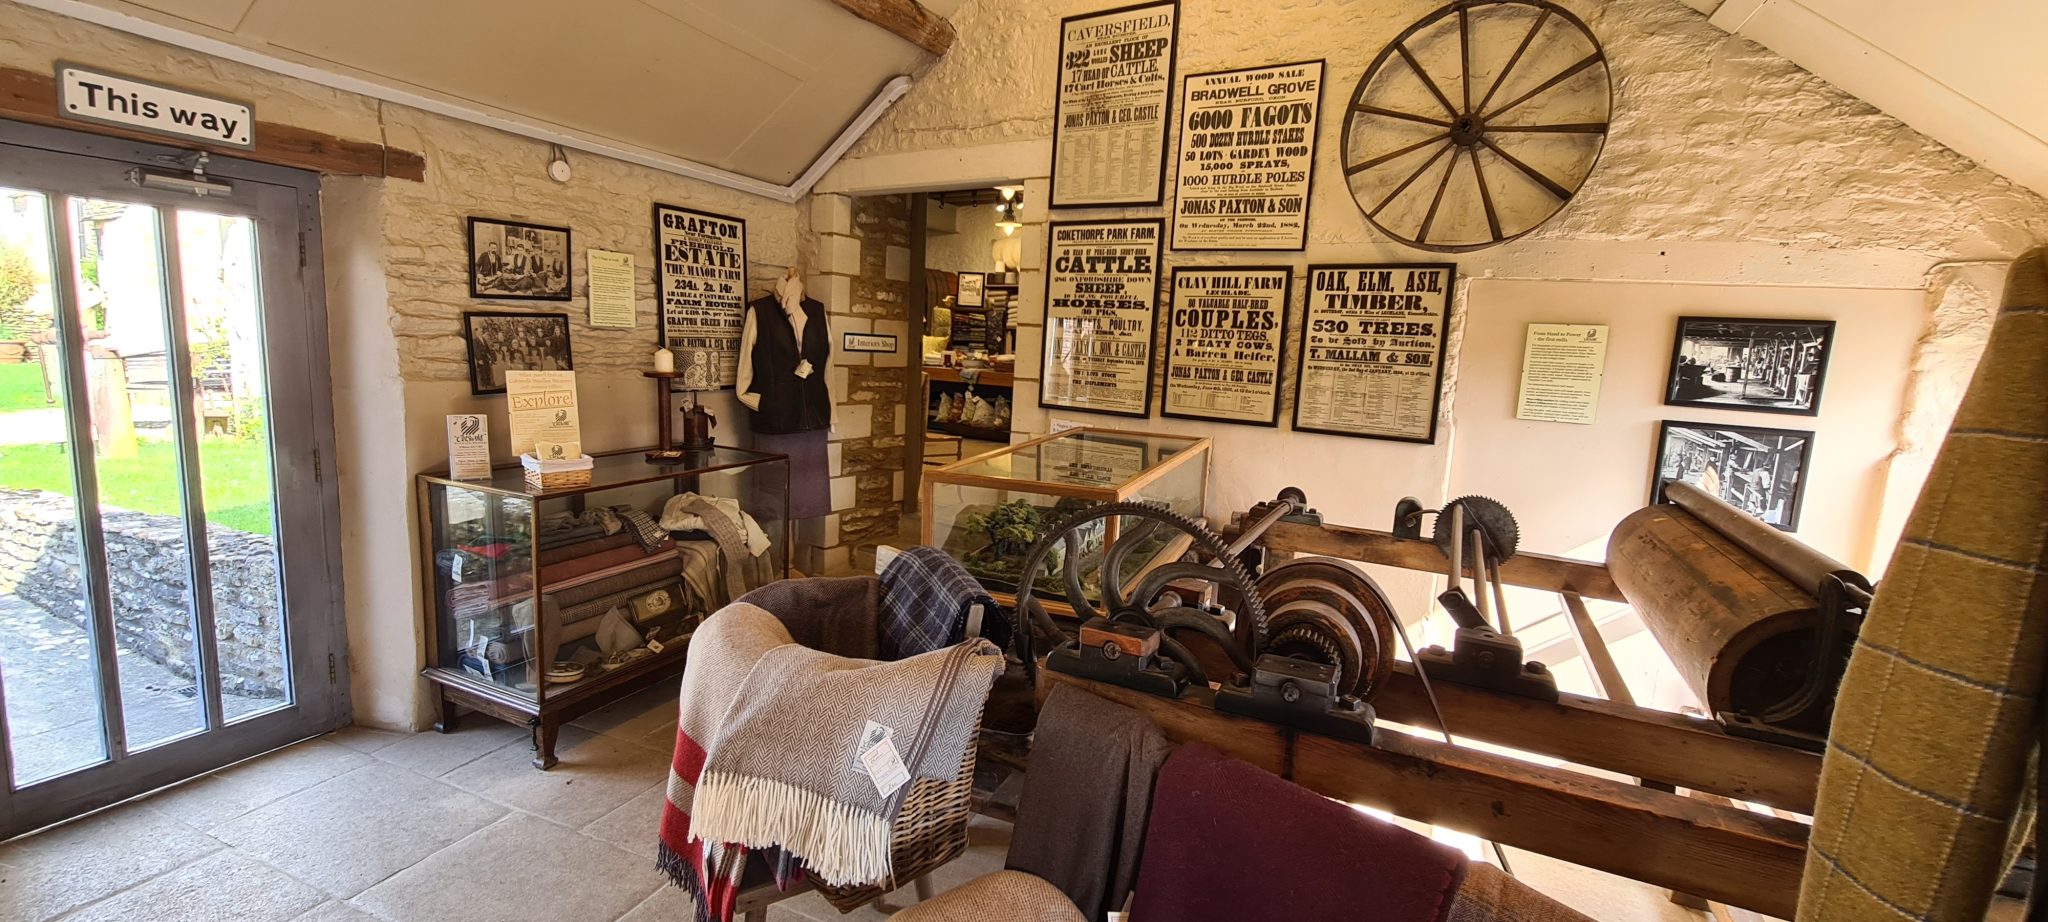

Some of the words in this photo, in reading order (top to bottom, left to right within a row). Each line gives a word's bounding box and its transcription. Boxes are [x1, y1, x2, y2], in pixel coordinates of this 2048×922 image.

[1067, 14, 1171, 42] CAVERSFIELD,
[1109, 37, 1169, 64] SHEEP
[1066, 49, 1090, 70] 322
[1071, 69, 1083, 83] 17
[1083, 68, 1100, 82] HEAD
[1102, 67, 1110, 80] OF
[1204, 75, 1241, 86] ANNUAL
[1246, 72, 1274, 82] WOOD
[1278, 69, 1305, 78] SALE
[1064, 84, 1075, 93] 17
[1075, 81, 1094, 92] Cart
[1096, 78, 1129, 89] Horses
[1191, 85, 1264, 101] BRADWELL
[1268, 80, 1316, 95] GROVE
[78, 81, 159, 119] This
[170, 106, 238, 139] way
[1064, 113, 1084, 128] JONAS
[1085, 109, 1110, 126] PAXTON
[1112, 110, 1117, 123] &
[1134, 105, 1159, 121] CASTLE
[1188, 109, 1233, 131] 6000
[1240, 102, 1313, 129] FAGOTS
[1191, 133, 1207, 148] 500
[1209, 131, 1234, 148] DOZEN
[1236, 130, 1271, 146] HURDLE
[1272, 127, 1305, 144] STAKES
[1185, 151, 1196, 161] 50
[1200, 150, 1224, 161] LOTS
[1230, 148, 1270, 159] GARDEN
[1276, 146, 1308, 158] WOOD
[1200, 162, 1233, 172] 15,000
[1240, 159, 1290, 170] SPRAYS,
[1183, 175, 1208, 186] 1000
[1212, 173, 1262, 185] HURDLE
[1266, 171, 1305, 184] POLES
[1181, 200, 1216, 215] JONAS
[1218, 198, 1267, 214] PAXTON
[1268, 198, 1276, 213] &
[1278, 197, 1303, 213] SON
[1057, 228, 1105, 241] COKETHORPE
[1107, 228, 1128, 240] PARK
[671, 239, 734, 252] FREEHOLD
[664, 244, 741, 269] ESTATE
[665, 263, 685, 275] THE
[688, 265, 716, 278] MANOR
[718, 268, 741, 281] FARM
[1055, 256, 1152, 275] CATTLE,
[1075, 283, 1127, 295] SHEEP,
[1178, 277, 1209, 289] CLAY
[1211, 277, 1242, 289] HILL
[1244, 277, 1283, 290] FARM
[1316, 271, 1350, 295] OAK,
[1357, 271, 1395, 293] ELM,
[1404, 271, 1443, 295] ASH,
[666, 298, 702, 307] FARM
[667, 291, 692, 299] ARABLE
[1199, 299, 1230, 309] VALUABLE
[1232, 299, 1269, 310] HALF-BRED
[1324, 294, 1429, 313] TIMBER,
[667, 316, 697, 326] GRAFTON
[701, 318, 720, 327] GREEN
[1109, 319, 1144, 332] POULTRY,
[1175, 309, 1279, 331] COUPLES,
[1312, 320, 1349, 333] 530
[1181, 328, 1198, 338] 112
[1200, 329, 1235, 340] DITTO
[1328, 336, 1338, 344] be
[1343, 336, 1367, 345] Sold
[1373, 337, 1386, 347] by
[687, 339, 706, 348] PAXTON
[1115, 343, 1119, 355] &
[1122, 343, 1146, 359] CASTLE
[1186, 349, 1227, 359] Barren
[1310, 348, 1320, 359] T.
[1325, 349, 1382, 362] MALLAM
[1386, 352, 1399, 362] &
[1405, 353, 1433, 366] SON,
[1171, 366, 1191, 378] JONAS
[1194, 367, 1220, 381] PAXTON
[1223, 369, 1228, 381] &
[1247, 371, 1273, 385] CASTLE
[512, 391, 574, 409] Explore!
